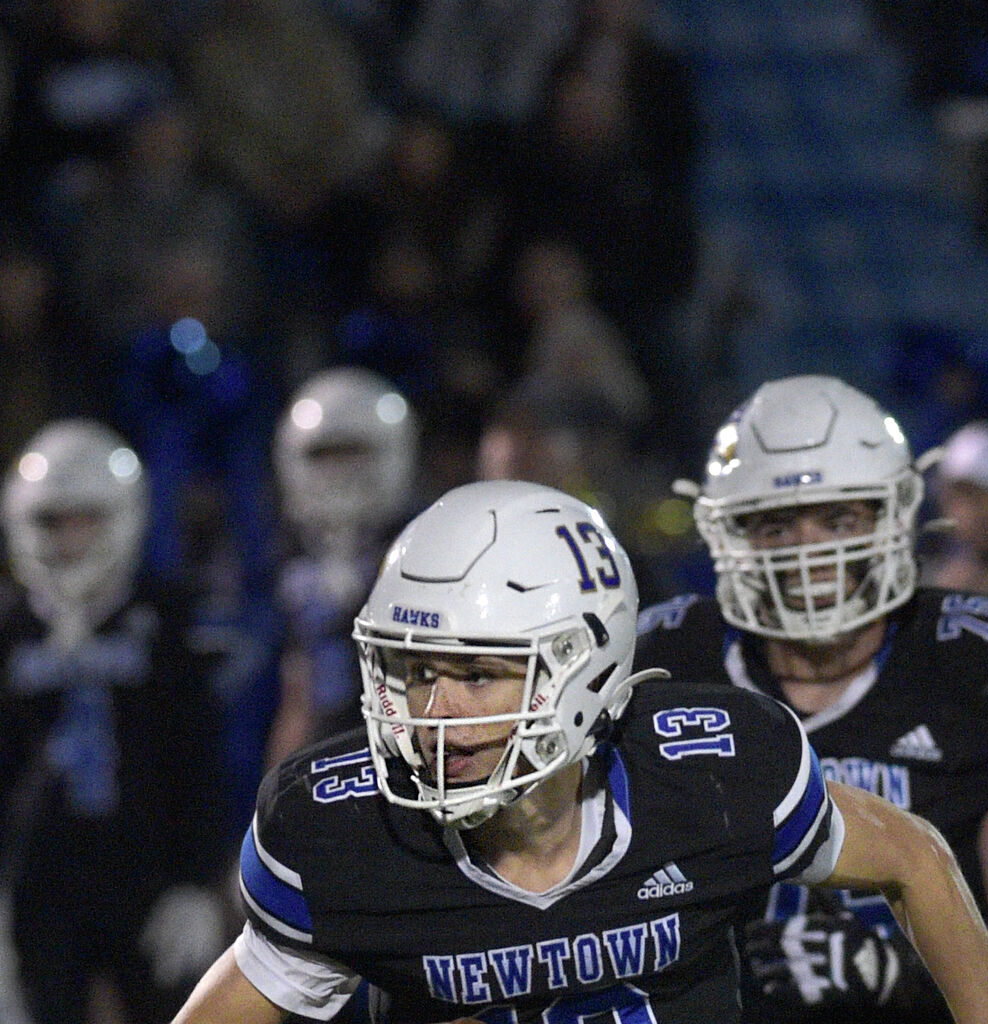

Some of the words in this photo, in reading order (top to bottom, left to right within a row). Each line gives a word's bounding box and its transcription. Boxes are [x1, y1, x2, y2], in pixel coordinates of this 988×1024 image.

[555, 522, 621, 594] 13
[393, 606, 440, 629] HAWKS
[652, 707, 736, 760] 13
[311, 747, 380, 804] 13
[637, 881, 694, 900] adidas
[422, 912, 681, 1005] NEWTOWN
